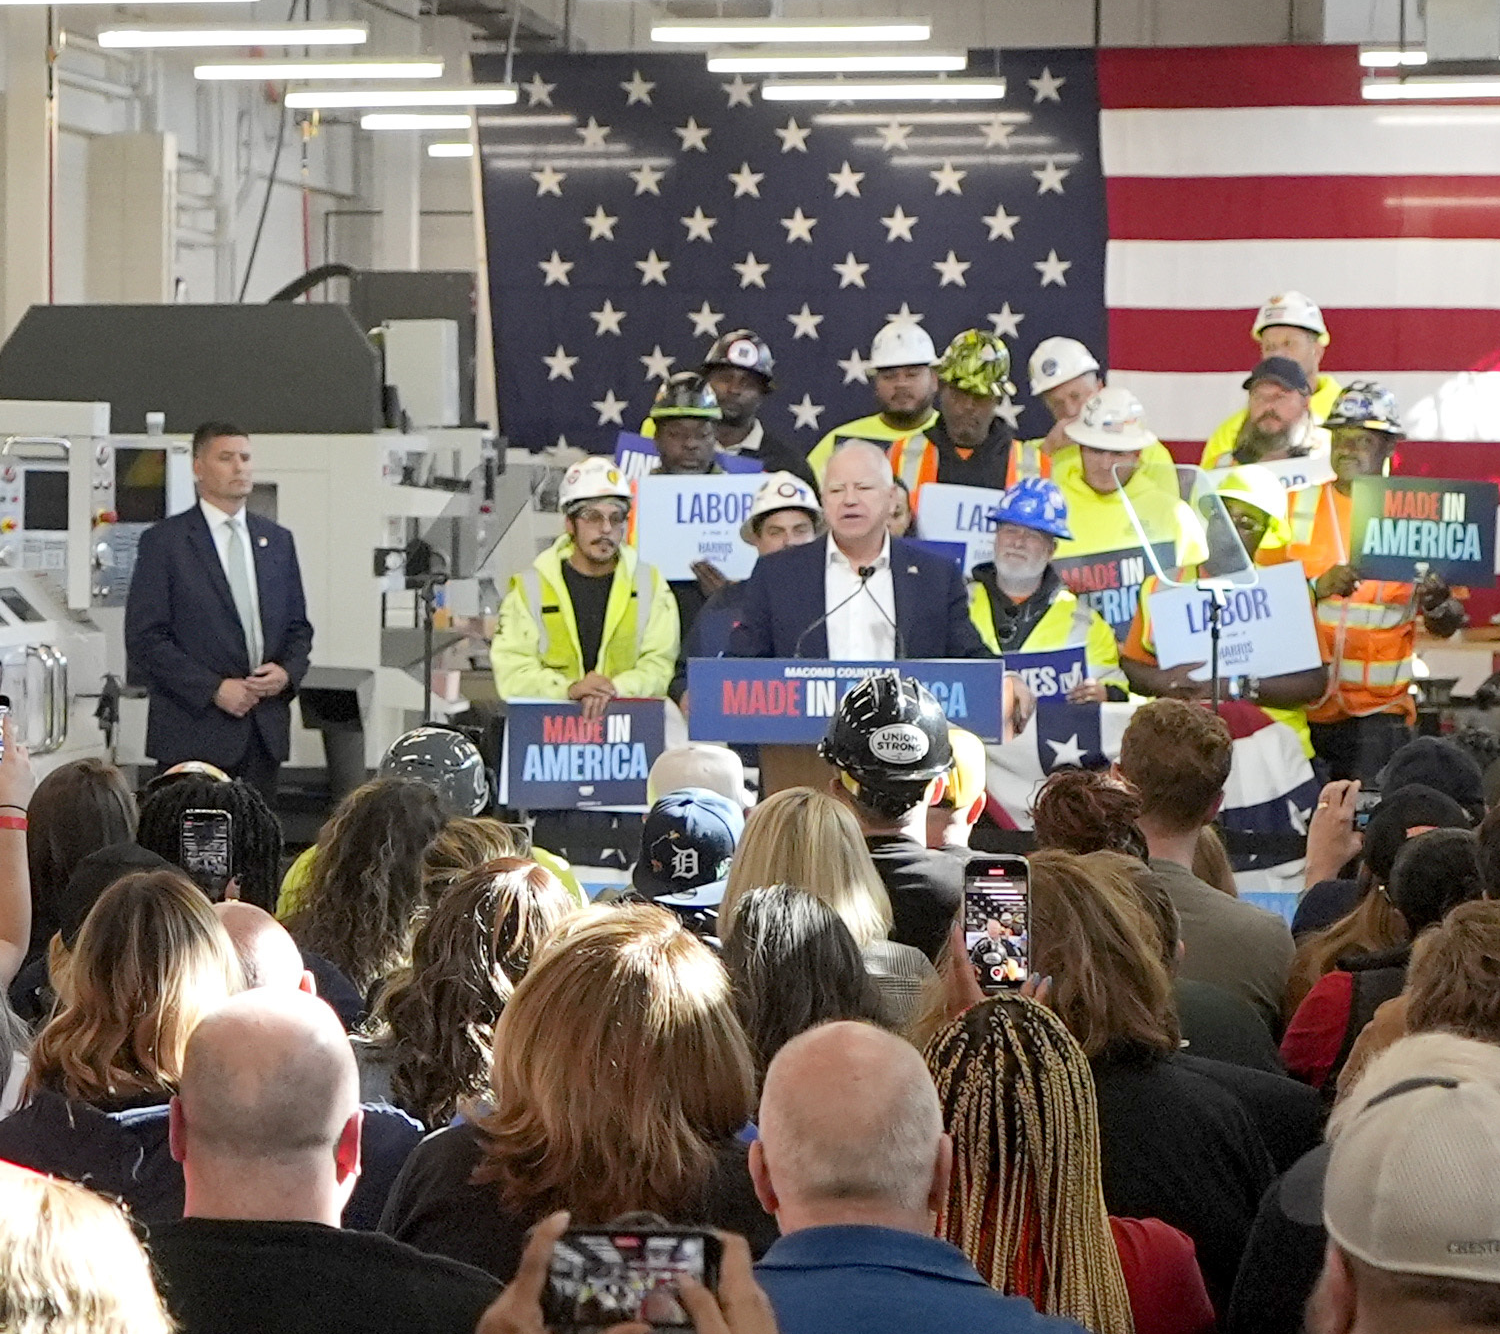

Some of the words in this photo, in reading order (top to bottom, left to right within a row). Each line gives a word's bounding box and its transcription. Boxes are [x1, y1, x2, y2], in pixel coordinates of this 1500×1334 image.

[1384, 490, 1440, 520] MADE
[1442, 492, 1466, 522] IN
[1362, 517, 1482, 561] AMERICA
[1121, 556, 1145, 586] IN
[784, 667, 836, 678] MACOMB
[722, 680, 800, 716] MADE
[806, 680, 837, 717] IN
[543, 715, 604, 743] MADE
[607, 714, 631, 744] IN
[882, 732, 918, 742] UNION
[877, 741, 922, 752] STRONG
[522, 742, 649, 782] AMERICA
